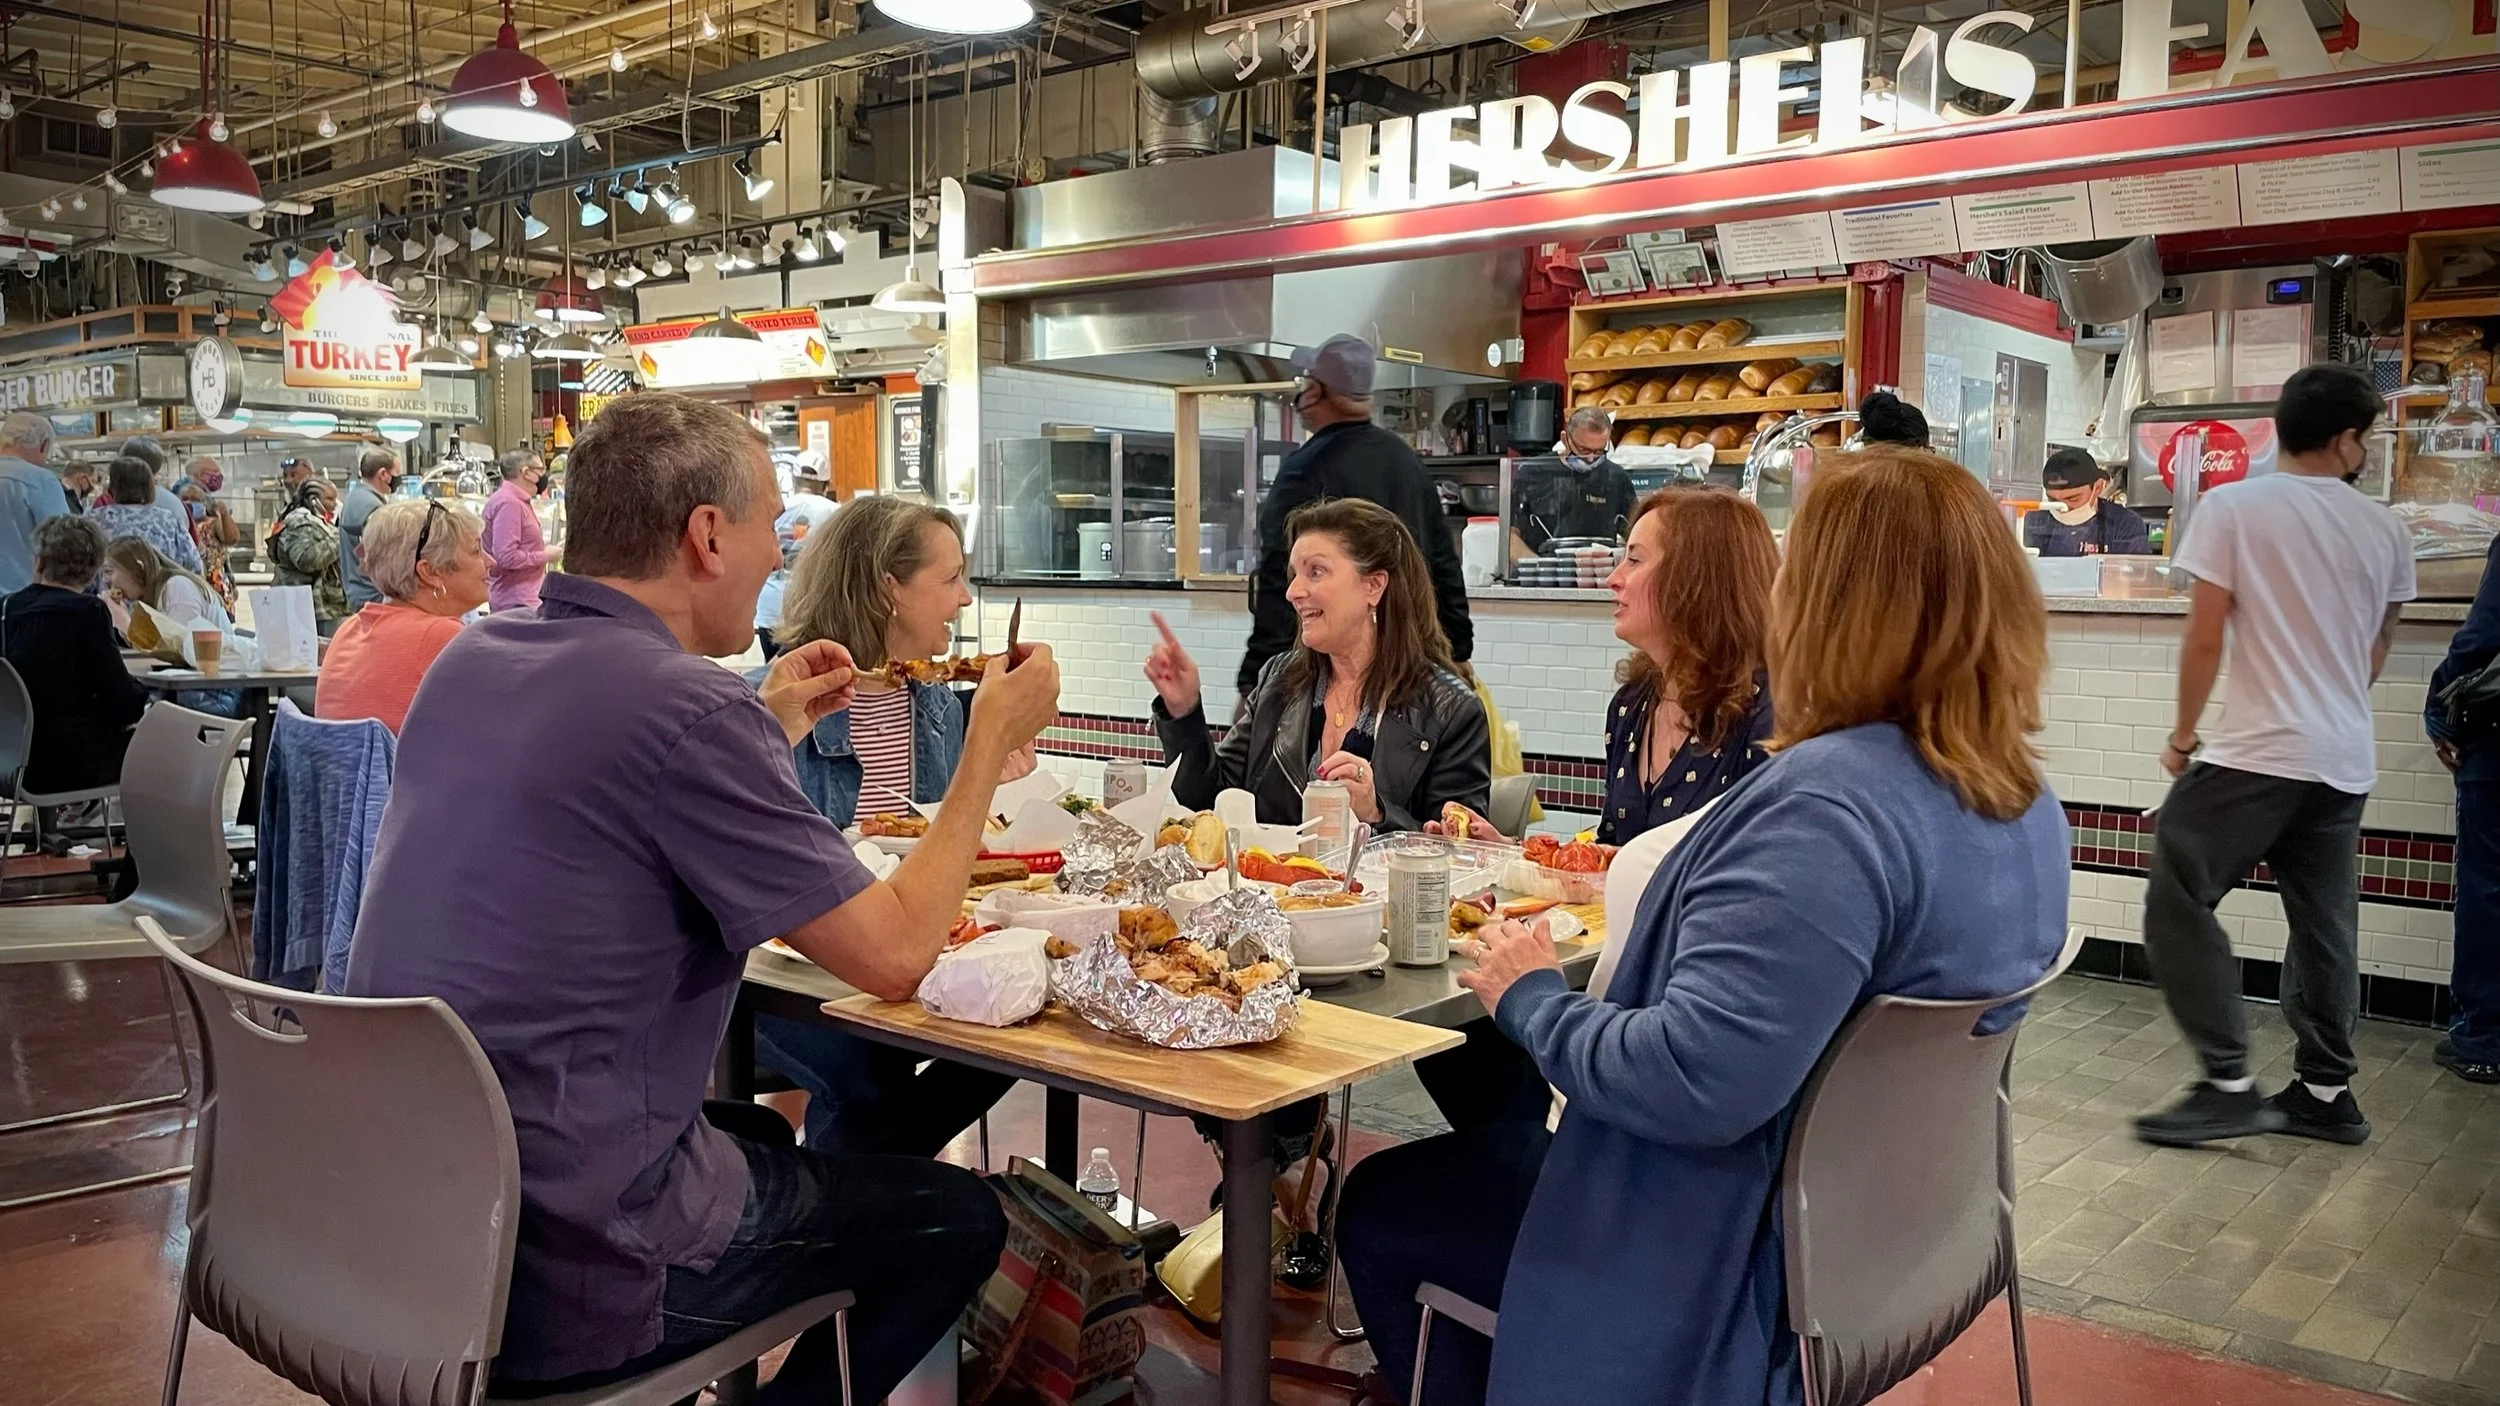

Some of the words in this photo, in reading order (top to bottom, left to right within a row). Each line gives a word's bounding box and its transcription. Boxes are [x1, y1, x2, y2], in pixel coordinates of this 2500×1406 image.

[2417, 158, 2441, 167] Sides
[2025, 205, 2050, 213] Platter
[1844, 214, 1881, 224] Traditional
[1881, 210, 1913, 220] Favorites
[780, 315, 815, 327] TURKEY
[313, 329, 338, 339] TH
[651, 328, 682, 340] CARVED
[289, 340, 412, 372] TURKEY
[349, 374, 382, 383] SINCE
[35, 365, 115, 406] BURGER
[308, 391, 369, 408] BURGERS
[377, 396, 427, 412] SHAKES
[434, 401, 468, 415] FRIES
